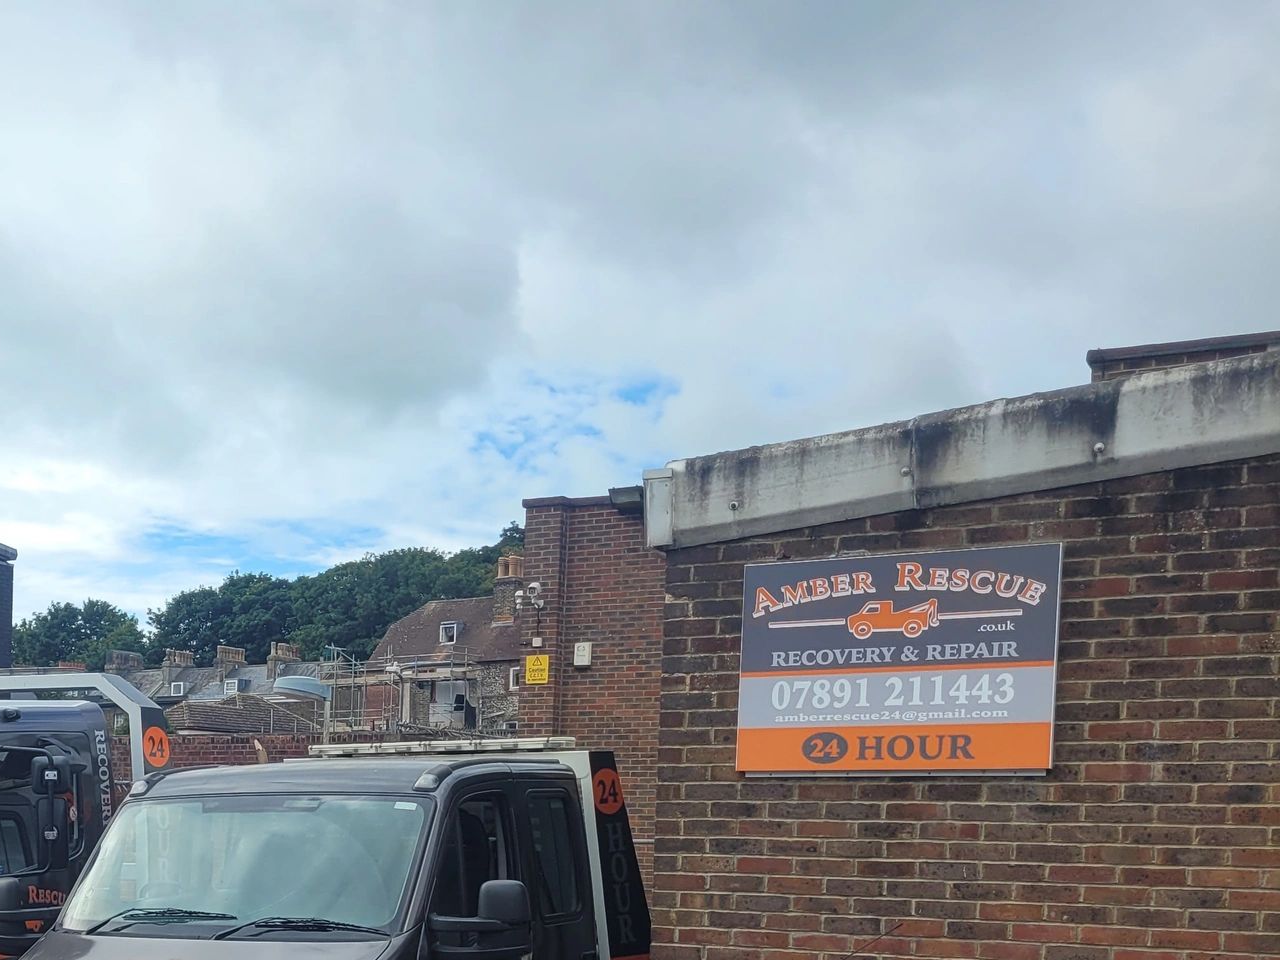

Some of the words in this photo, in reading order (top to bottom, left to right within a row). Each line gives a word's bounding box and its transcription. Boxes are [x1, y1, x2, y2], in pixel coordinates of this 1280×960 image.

[752, 571, 876, 618] AMBER
[895, 561, 1047, 606] RESCUE
[977, 620, 1015, 632] .co.uk
[771, 646, 895, 667] RECOVERY
[900, 644, 920, 662] &
[926, 641, 1019, 661] REPAIR
[771, 677, 871, 710] 07891
[884, 672, 1015, 706] 211443
[775, 708, 1009, 723] amberrescue24@gmail.com
[148, 735, 165, 758] 24
[809, 737, 841, 758] 24
[856, 734, 975, 761] HOUR
[597, 779, 619, 805] 24
